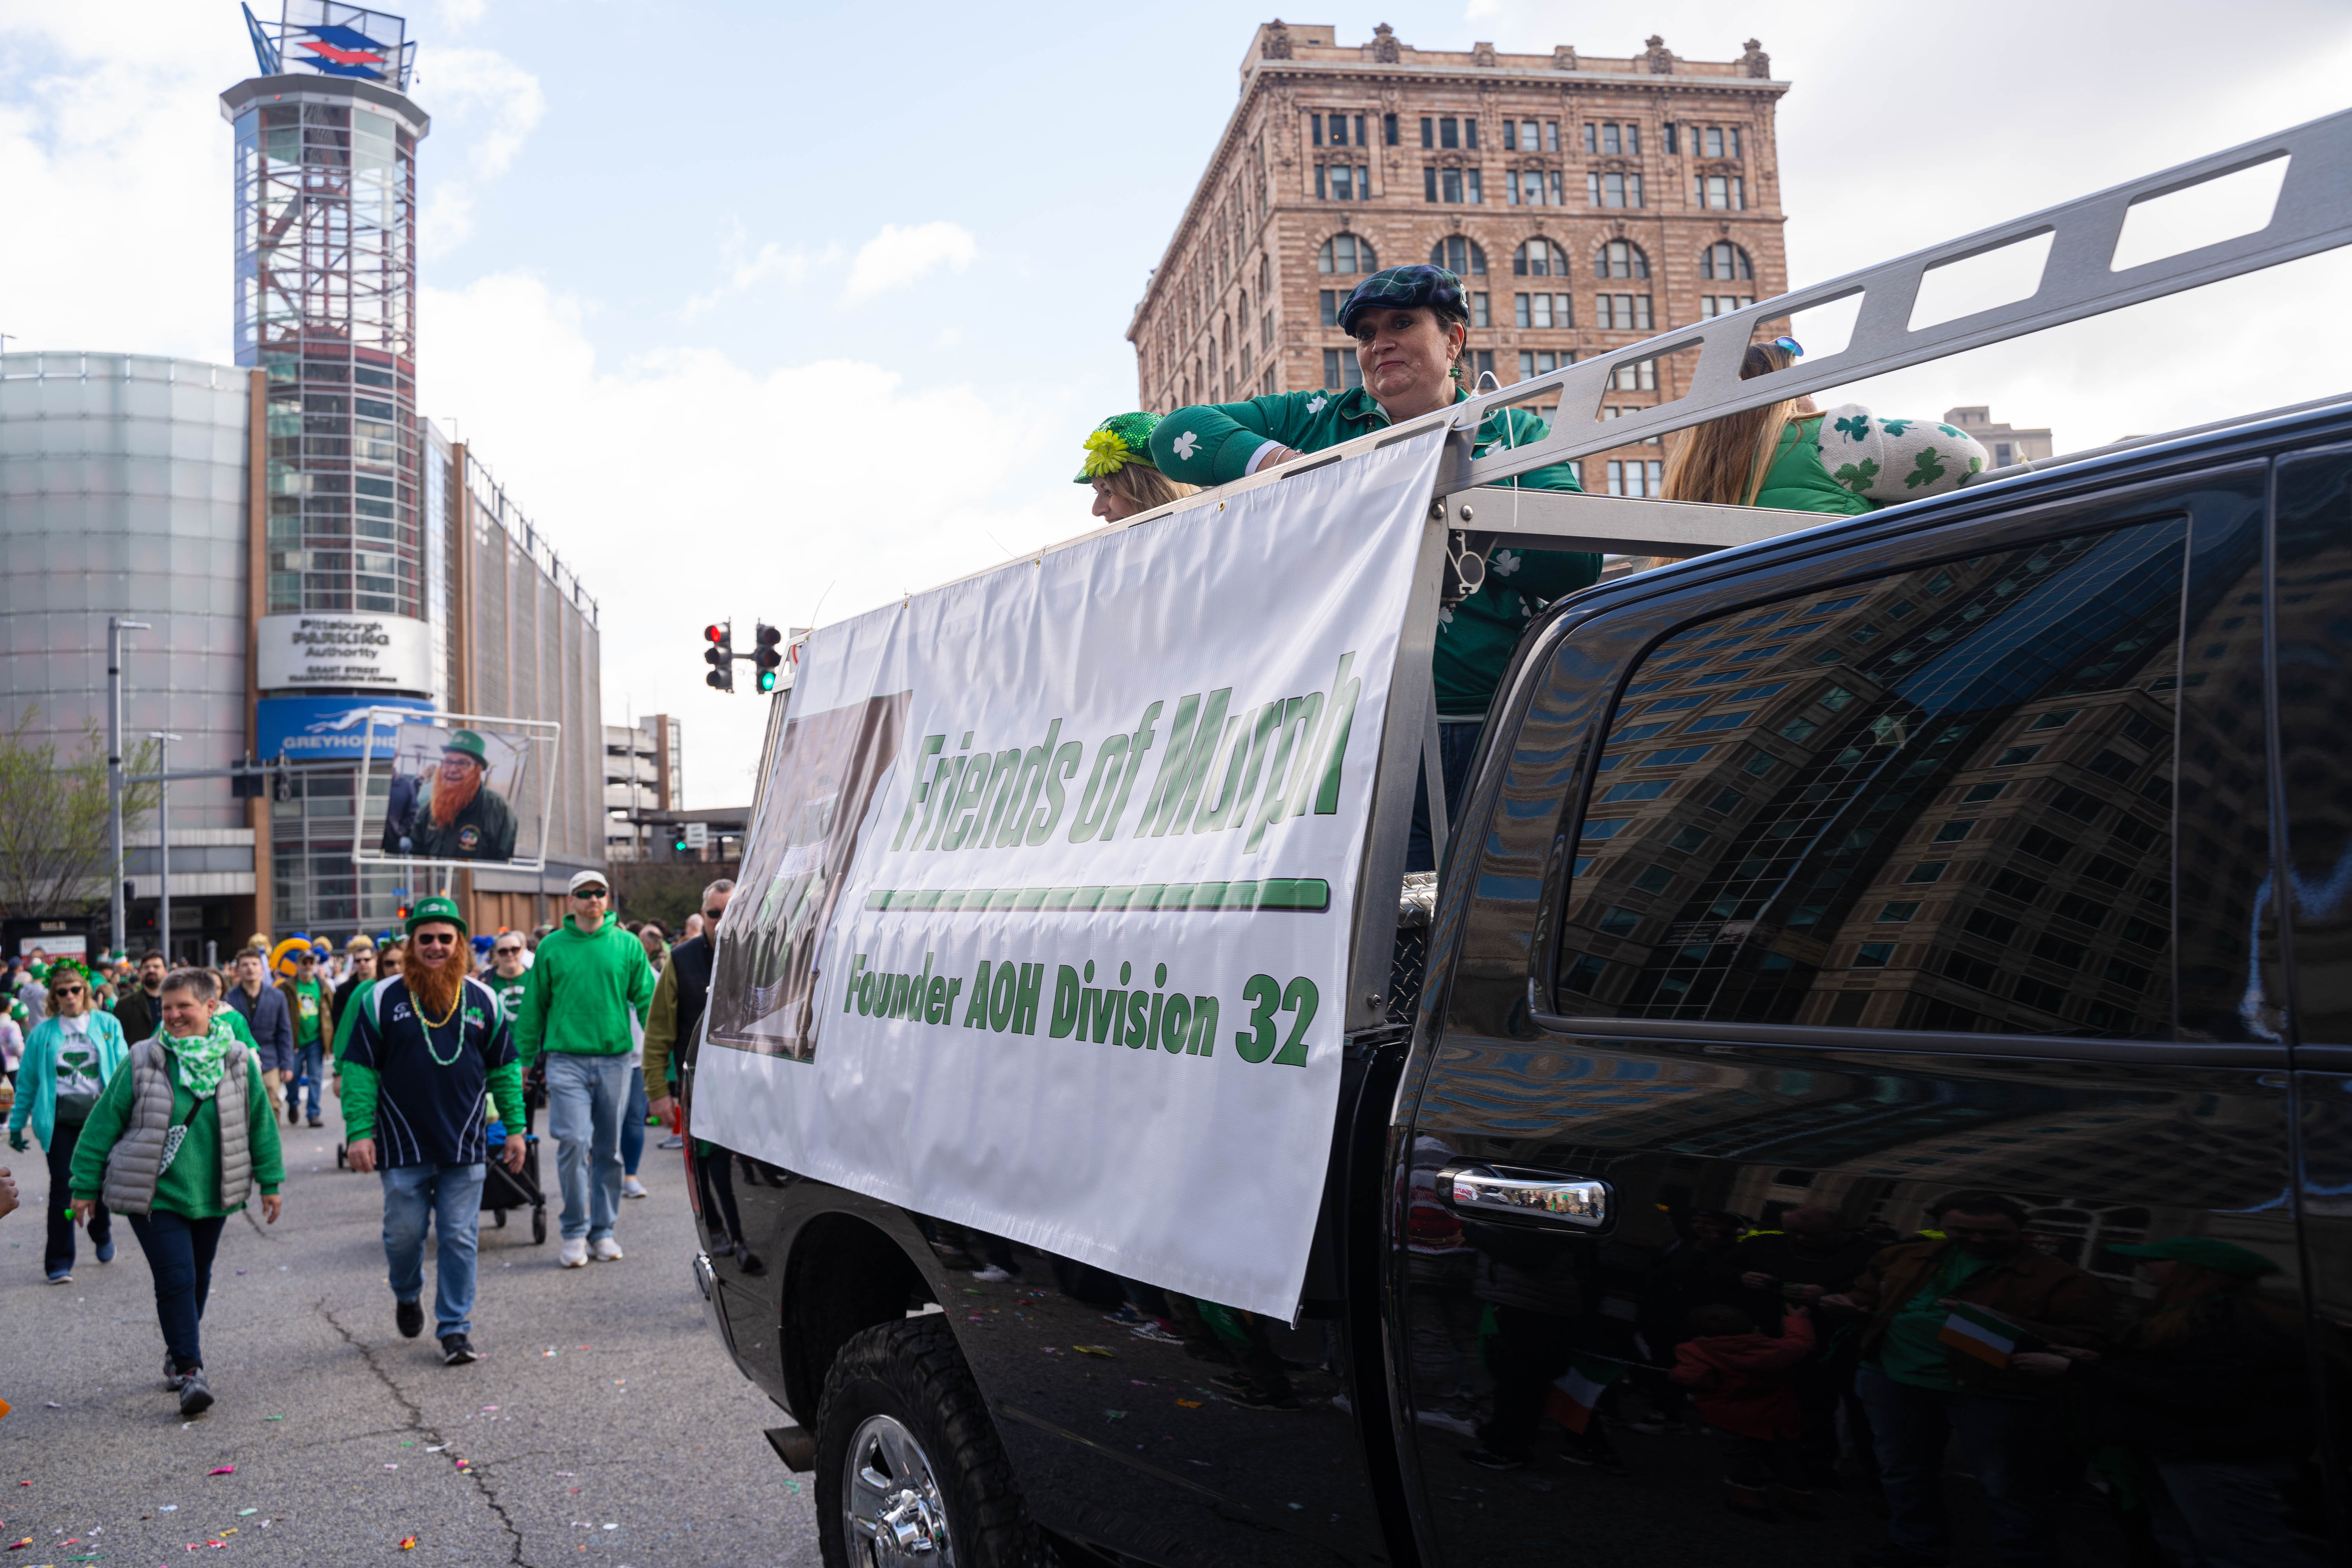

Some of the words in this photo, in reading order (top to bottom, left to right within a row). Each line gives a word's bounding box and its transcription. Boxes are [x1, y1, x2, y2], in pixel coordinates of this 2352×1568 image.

[301, 620, 382, 632] Pittsburgh
[292, 632, 389, 645] PARKING
[305, 648, 378, 659] Authority
[890, 718, 1083, 851] Friends
[1068, 700, 1164, 844] of
[1133, 651, 1361, 855] Murph
[843, 952, 962, 1025] Founder
[963, 960, 1044, 1036] AOH
[1049, 959, 1220, 1057] Division
[1236, 974, 1319, 1068] 32
